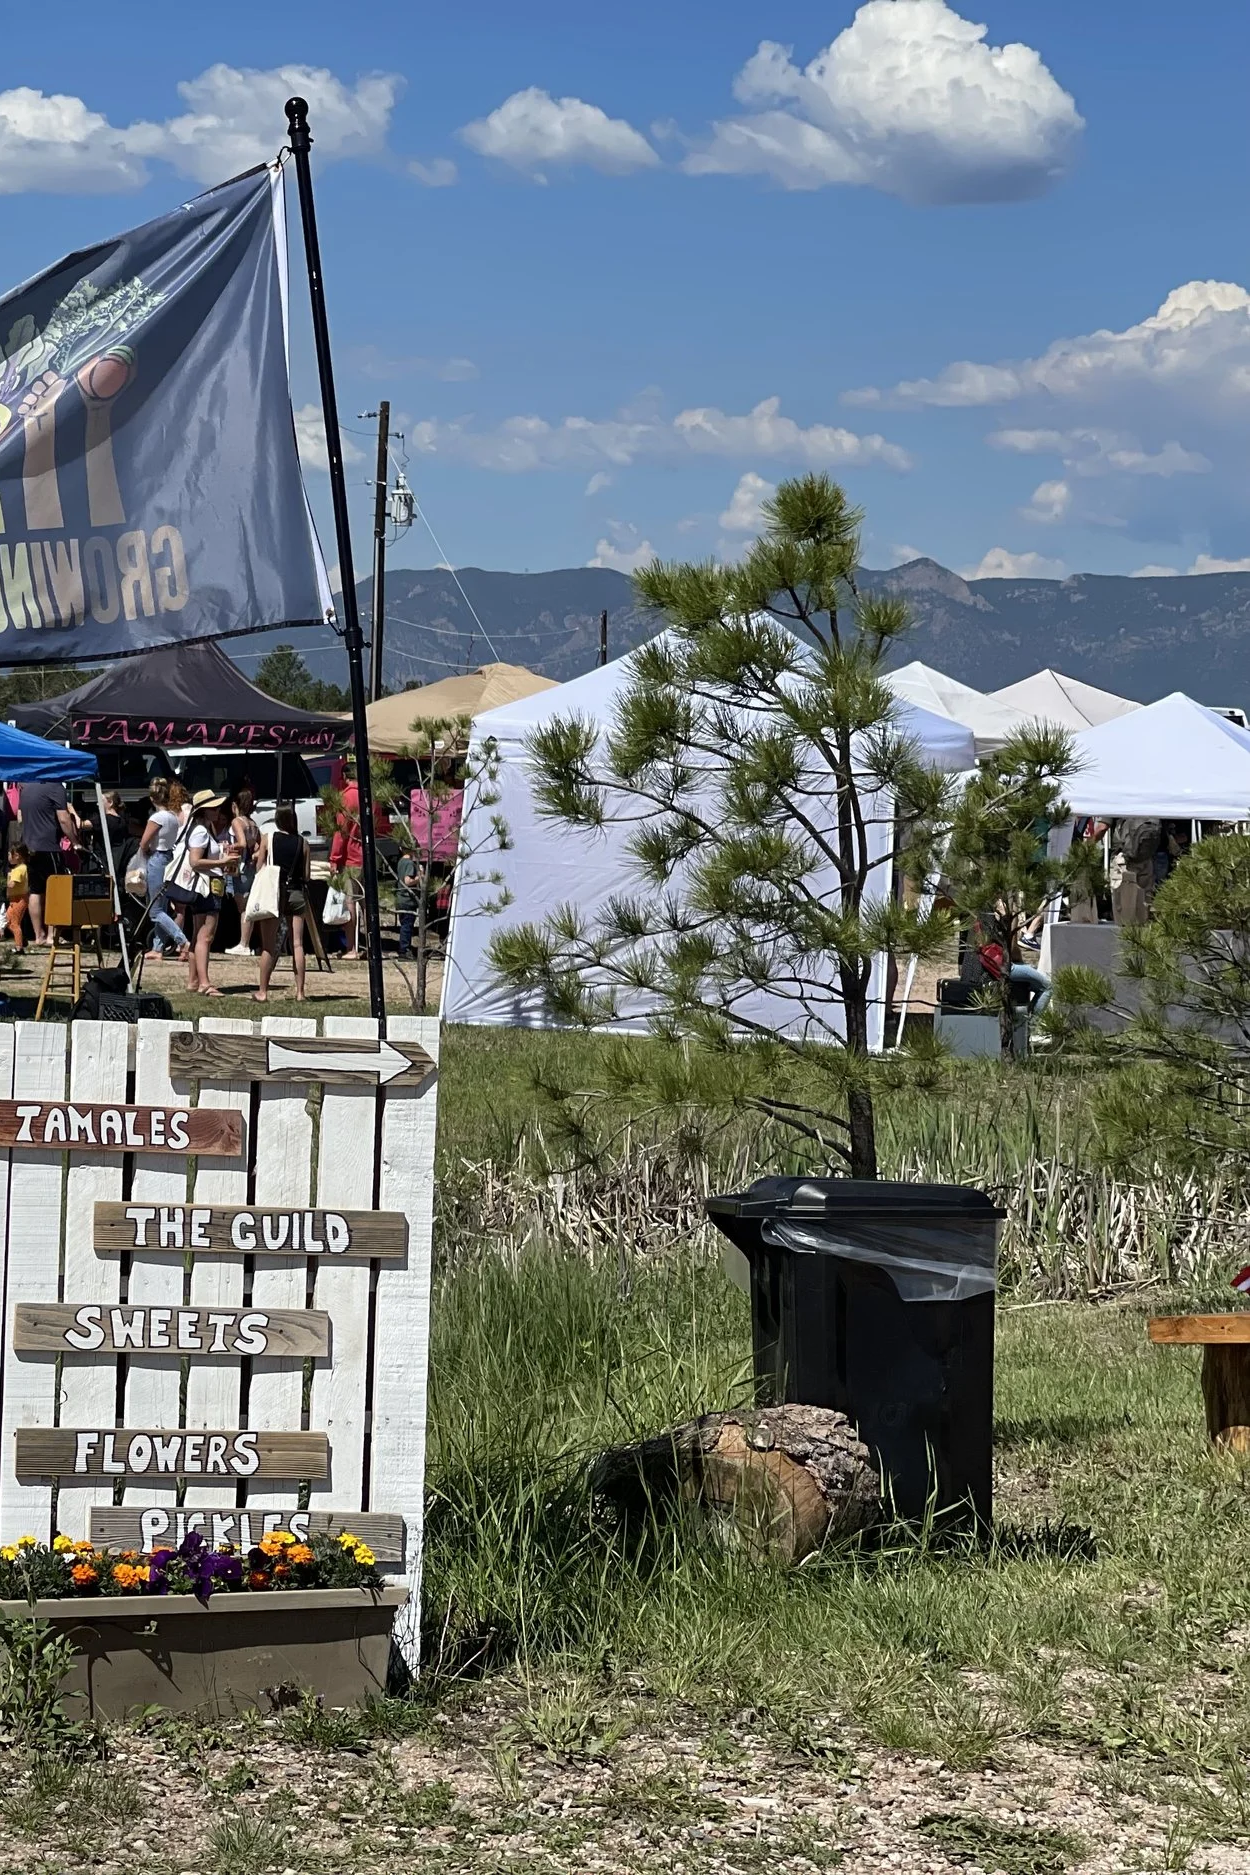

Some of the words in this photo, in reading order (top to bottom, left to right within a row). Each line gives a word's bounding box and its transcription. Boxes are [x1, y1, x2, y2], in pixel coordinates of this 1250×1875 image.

[72, 716, 285, 750] TAMALES
[285, 727, 335, 751] Lady
[15, 1105, 190, 1150] TAMALES
[125, 1206, 212, 1248] THE
[230, 1211, 351, 1253] GUILD
[64, 1305, 269, 1355] SWEETS
[73, 1431, 260, 1477] FLOWERS
